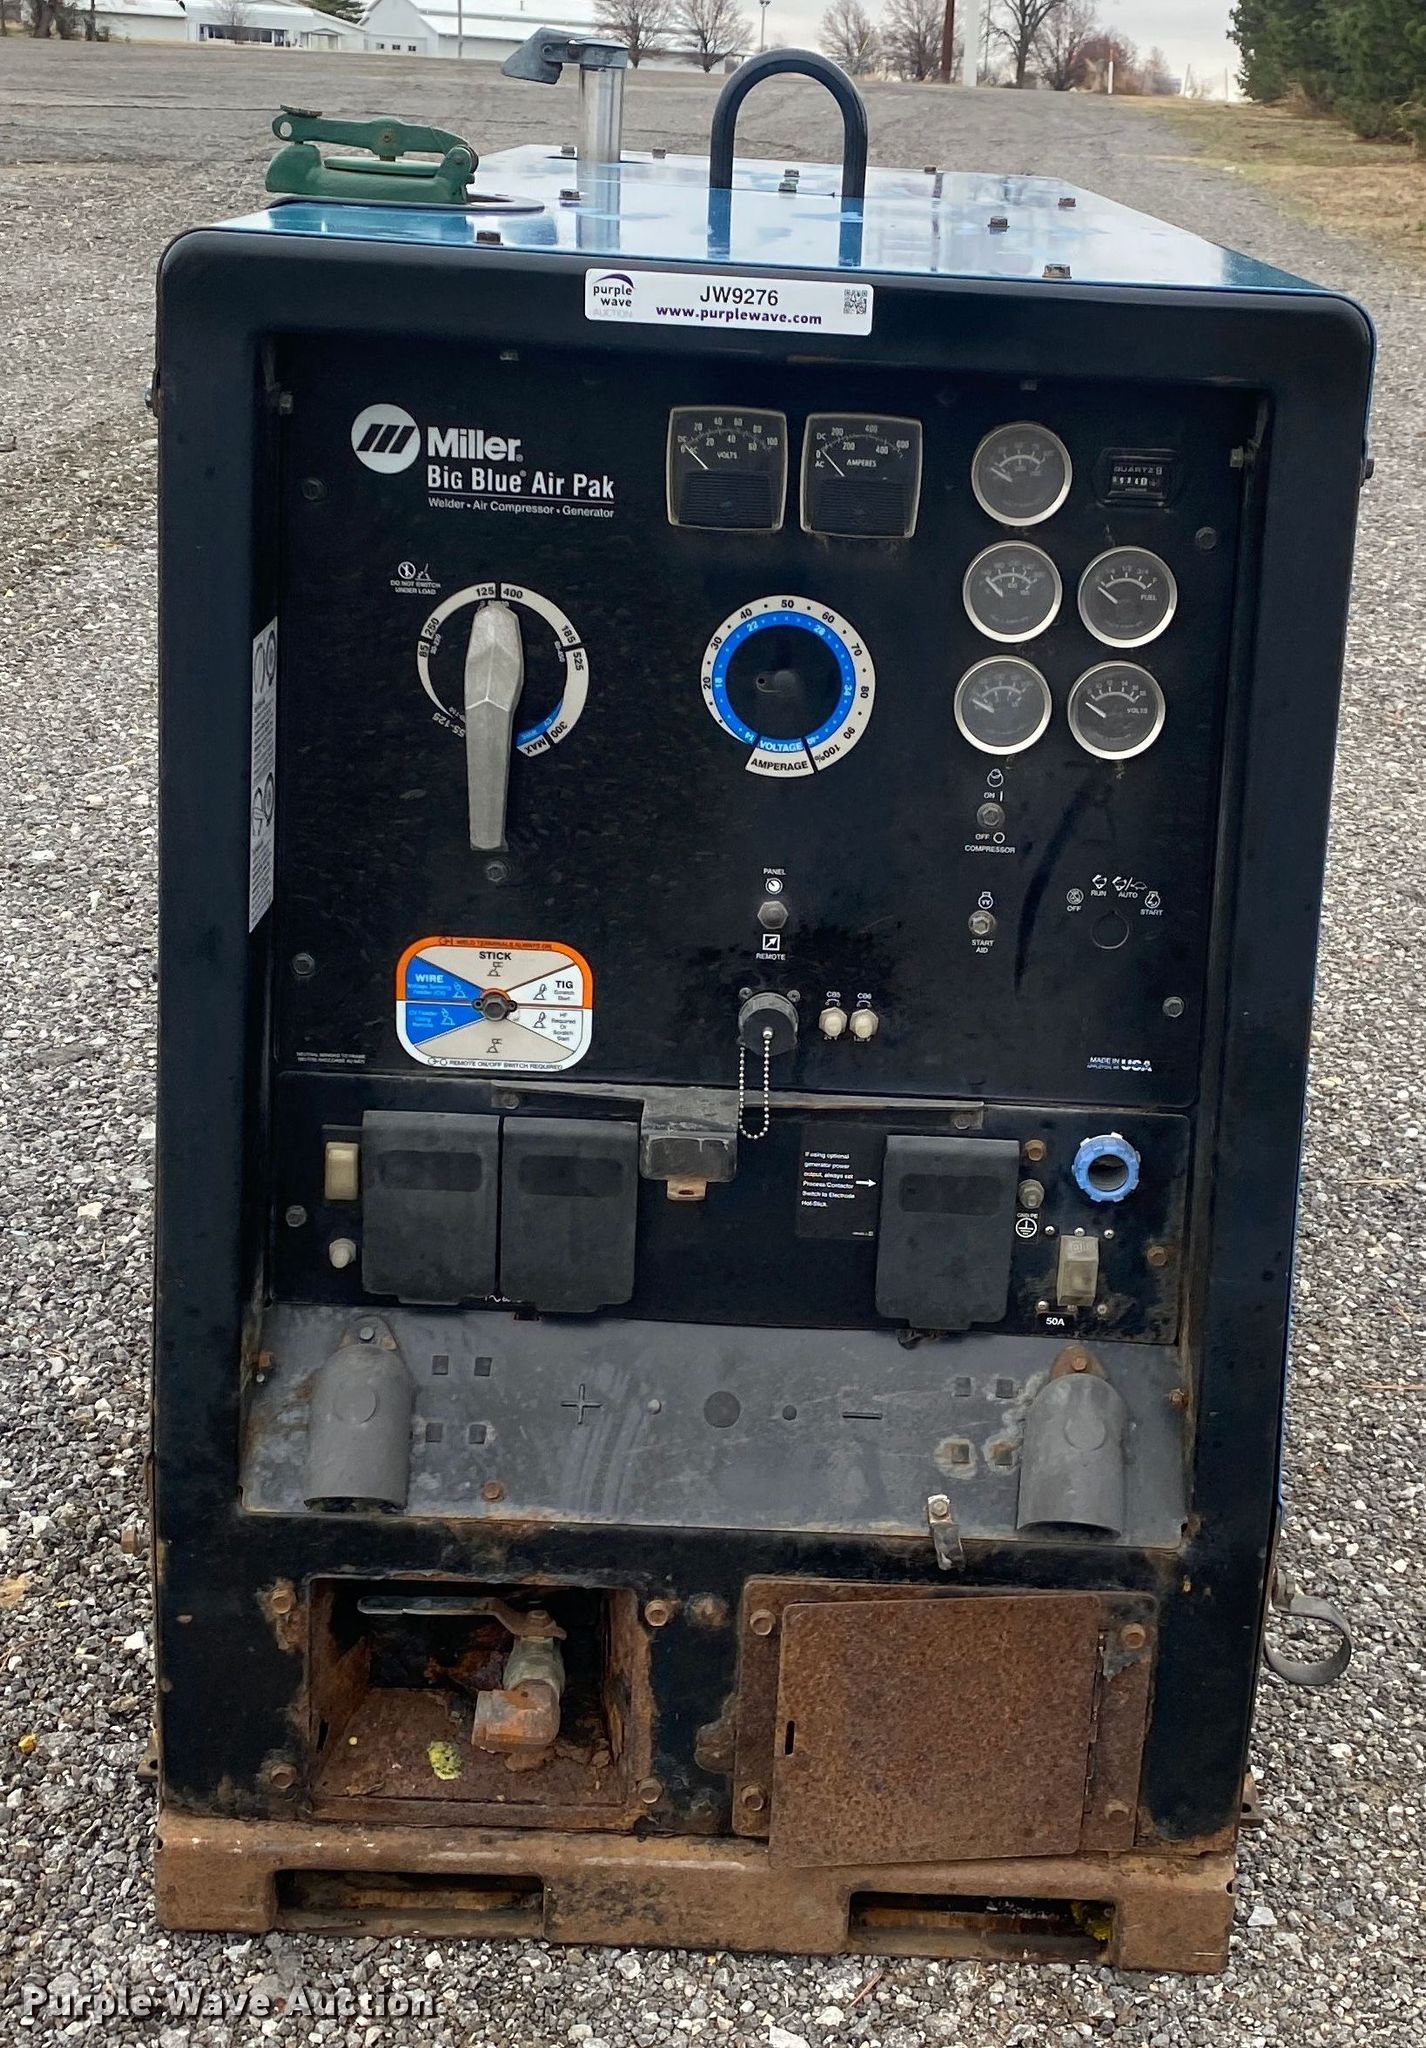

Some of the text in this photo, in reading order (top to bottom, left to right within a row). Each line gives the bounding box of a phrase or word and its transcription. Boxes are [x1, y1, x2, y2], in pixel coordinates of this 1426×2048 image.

[593, 284, 632, 297] purple
[700, 285, 779, 306] JW9276
[600, 297, 632, 307] wave
[656, 304, 822, 325] www.purplewave.com
[427, 426, 522, 462] Miller
[717, 451, 737, 459] VOLTS
[846, 459, 877, 468] AMPERES
[427, 464, 614, 499] Big Blue Air Pak
[428, 497, 614, 518] Welder Air Compressor Generator
[476, 587, 495, 597] 125
[503, 588, 523, 599] 400
[781, 600, 794, 609] 50
[739, 608, 753, 621] 40
[821, 611, 835, 624] 60
[424, 617, 440, 637] 250
[746, 620, 759, 632] 22
[561, 625, 576, 643] 185
[710, 637, 723, 650] 30
[851, 643, 863, 657] 70
[419, 644, 429, 658] 85
[573, 651, 584, 671] 525
[702, 677, 712, 690] 20
[860, 686, 870, 699] 80
[432, 712, 466, 738] 55-125
[550, 721, 568, 738] 300
[843, 726, 856, 739] 90
[525, 737, 547, 754] MAX
[759, 739, 804, 752] VOLTAGE
[814, 743, 841, 762] 100%
[751, 758, 809, 771] AMPERAGE
[975, 833, 990, 841] OFF
[964, 844, 1016, 854] COMPRESSOR
[763, 867, 786, 875] PANEL
[1091, 889, 1107, 897] RUN
[1118, 891, 1138, 899] AUTO
[1140, 908, 1163, 917] START
[971, 939, 994, 947] START
[479, 951, 512, 961] STICK
[756, 953, 786, 961] REMOTE
[976, 947, 988, 955] AID
[415, 974, 444, 983] WIRE
[555, 981, 574, 989] TIG
[1090, 1056, 1111, 1064] MADE
[1121, 1059, 1152, 1071] USA
[1045, 1317, 1065, 1327] 50A
